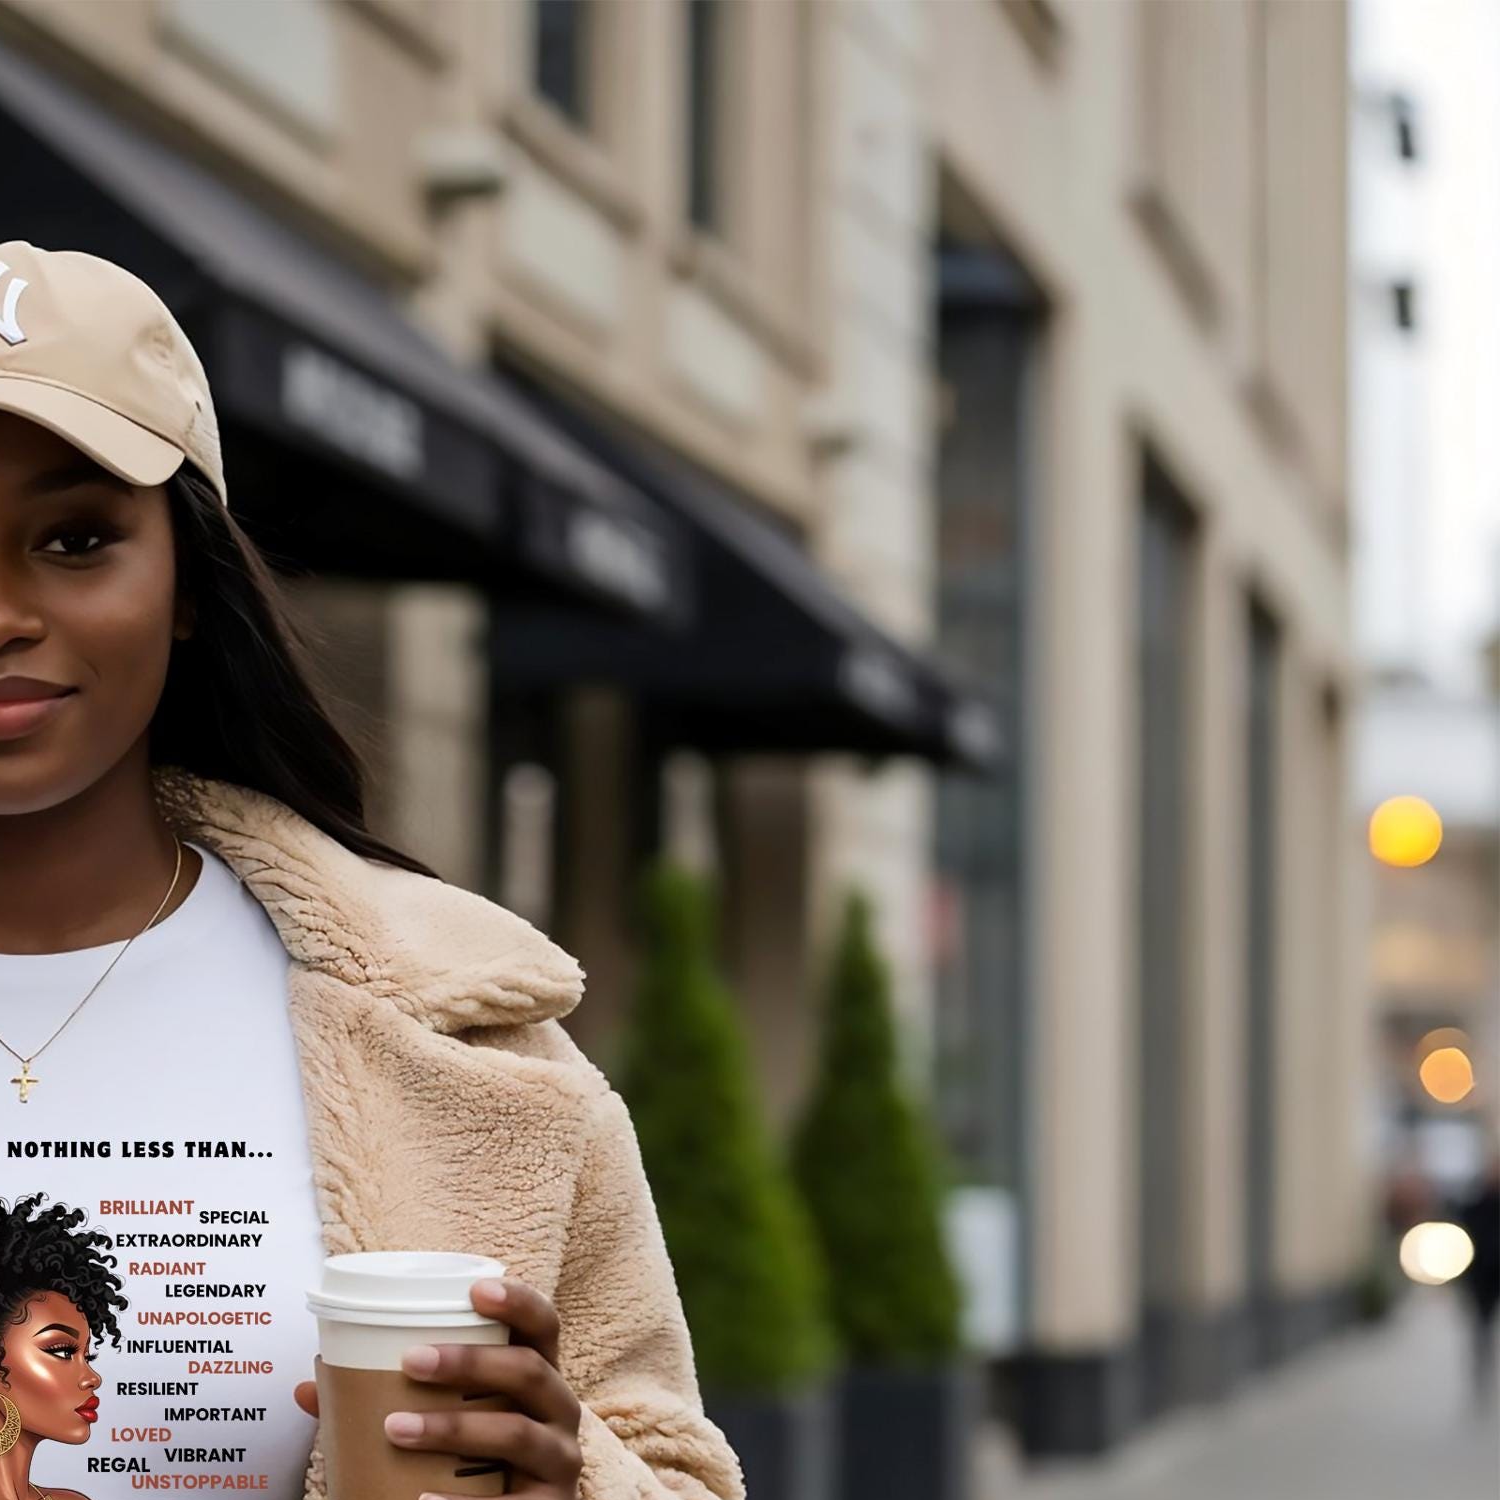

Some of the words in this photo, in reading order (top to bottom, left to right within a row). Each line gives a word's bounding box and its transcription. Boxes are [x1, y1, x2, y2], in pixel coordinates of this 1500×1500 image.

[7, 1141, 111, 1159] NOTHING
[121, 1141, 175, 1159] LESS
[184, 1141, 273, 1158] THAN...
[99, 1199, 195, 1215] BRILLIANT
[199, 1210, 270, 1225] SPECIAL
[115, 1233, 263, 1248] EXTRAORDINARY
[129, 1261, 207, 1276] RADIANT
[165, 1283, 267, 1298] LEGENDARY
[137, 1311, 272, 1326] UNAPOLOGETIC
[127, 1339, 234, 1354] INFLUENTIAL
[188, 1360, 274, 1375] DAZZLING
[116, 1382, 199, 1396] RESILIENT
[164, 1407, 267, 1422] IMPORTANT
[111, 1427, 172, 1443] LOVED
[163, 1447, 247, 1463] VIBRANT
[87, 1457, 151, 1473] REGAL
[131, 1474, 269, 1490] UNSTOPPABLE
